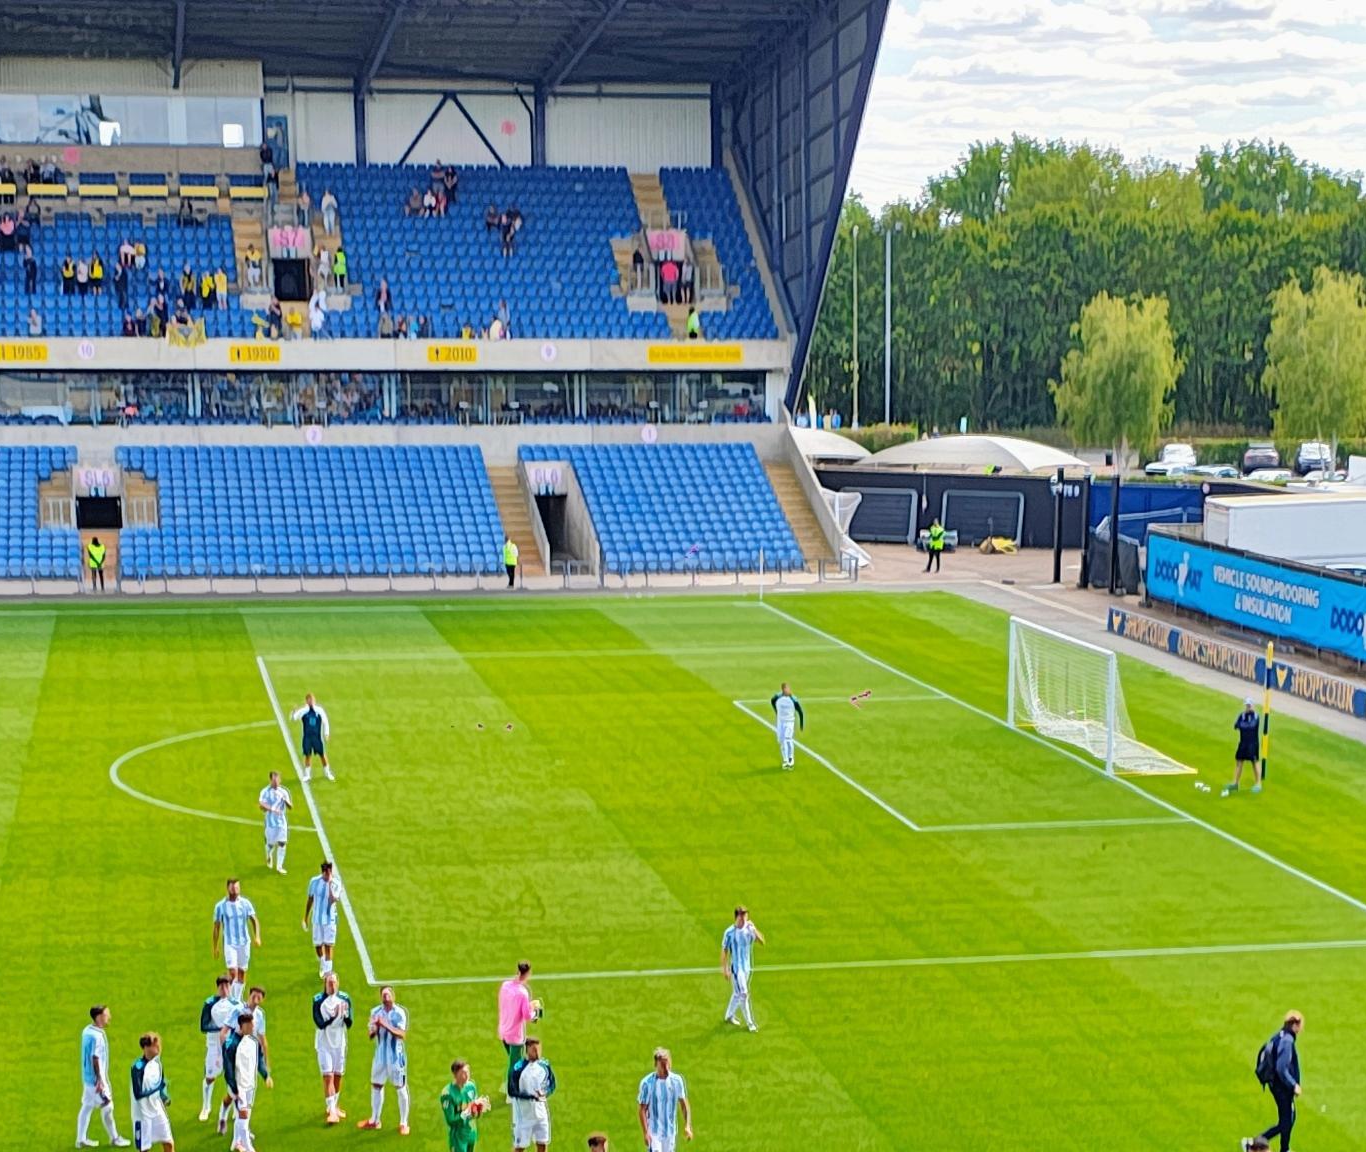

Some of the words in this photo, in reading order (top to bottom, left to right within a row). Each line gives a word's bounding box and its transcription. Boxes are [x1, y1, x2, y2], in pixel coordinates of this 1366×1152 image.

[1213, 564, 1245, 589] VEHICLE
[1241, 594, 1292, 625] INSULATION
[1330, 606, 1363, 634] DODO
